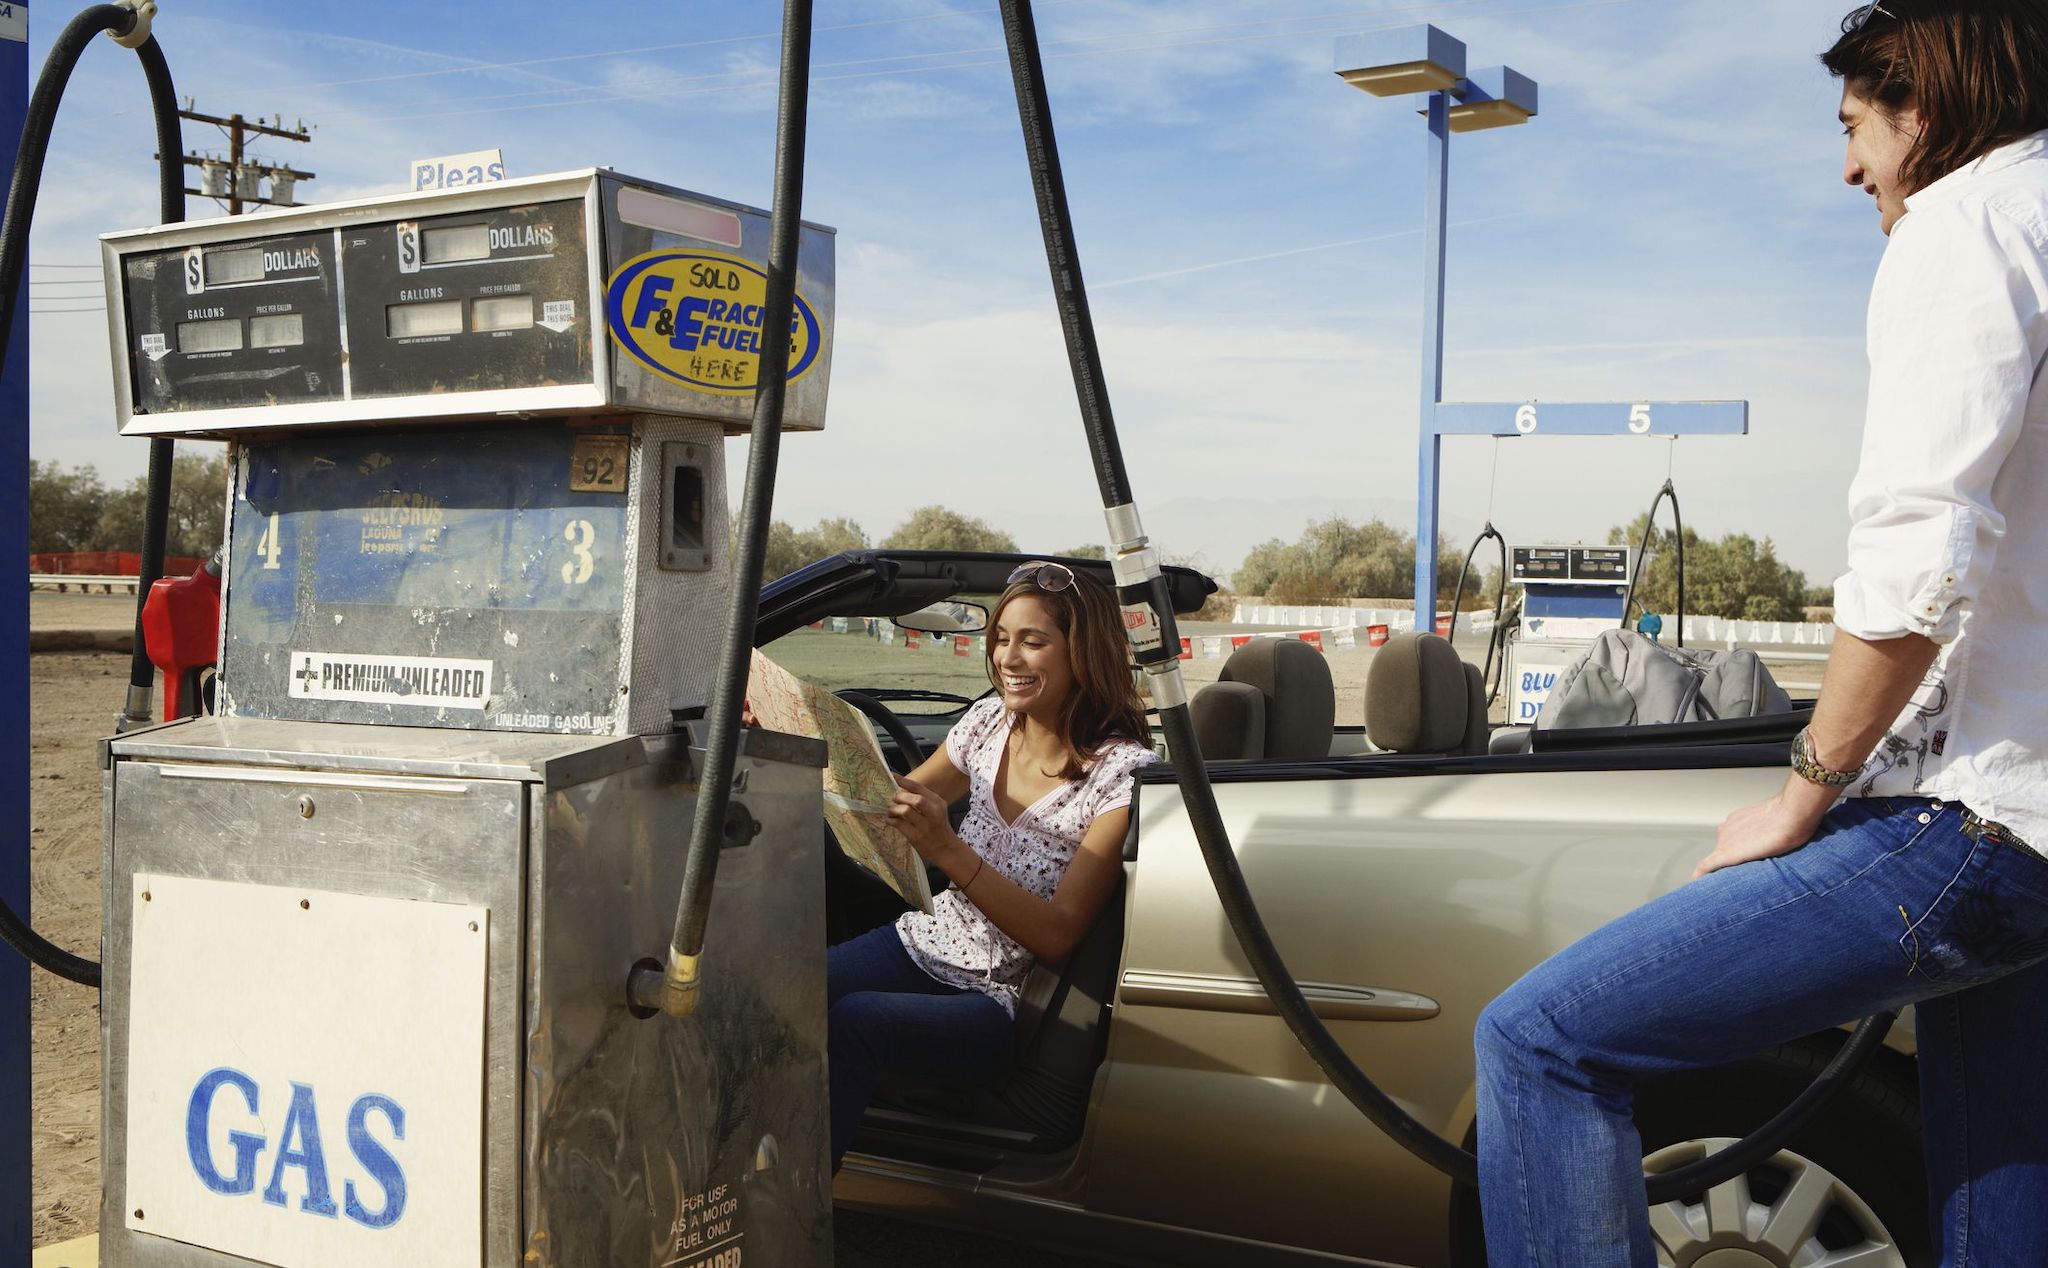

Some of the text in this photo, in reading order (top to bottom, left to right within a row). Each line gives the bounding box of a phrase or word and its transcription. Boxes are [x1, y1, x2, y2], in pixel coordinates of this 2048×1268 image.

[416, 162, 503, 191] Pleas
[402, 225, 554, 269] $ DOLLARS
[188, 249, 320, 290] $ DOLLARS
[689, 263, 741, 291] SOLD
[400, 287, 443, 301] GALLONS
[480, 283, 520, 294] PRICE PER GALLON
[187, 307, 224, 320] GALLONS
[546, 304, 558, 313] THIS
[690, 355, 749, 381] HERE
[1515, 404, 1651, 434] 6 5
[583, 457, 614, 484] 92
[257, 511, 281, 570] 4
[561, 520, 595, 585] 3
[322, 663, 396, 694] PREMIUM
[495, 713, 613, 729] UNLEADED GASOLINE
[185, 1066, 408, 1230] GAS
[671, 1198, 737, 1235] AS A MOTOR
[681, 1194, 704, 1213] FOR
[676, 1218, 732, 1252] FUEL ONLY
